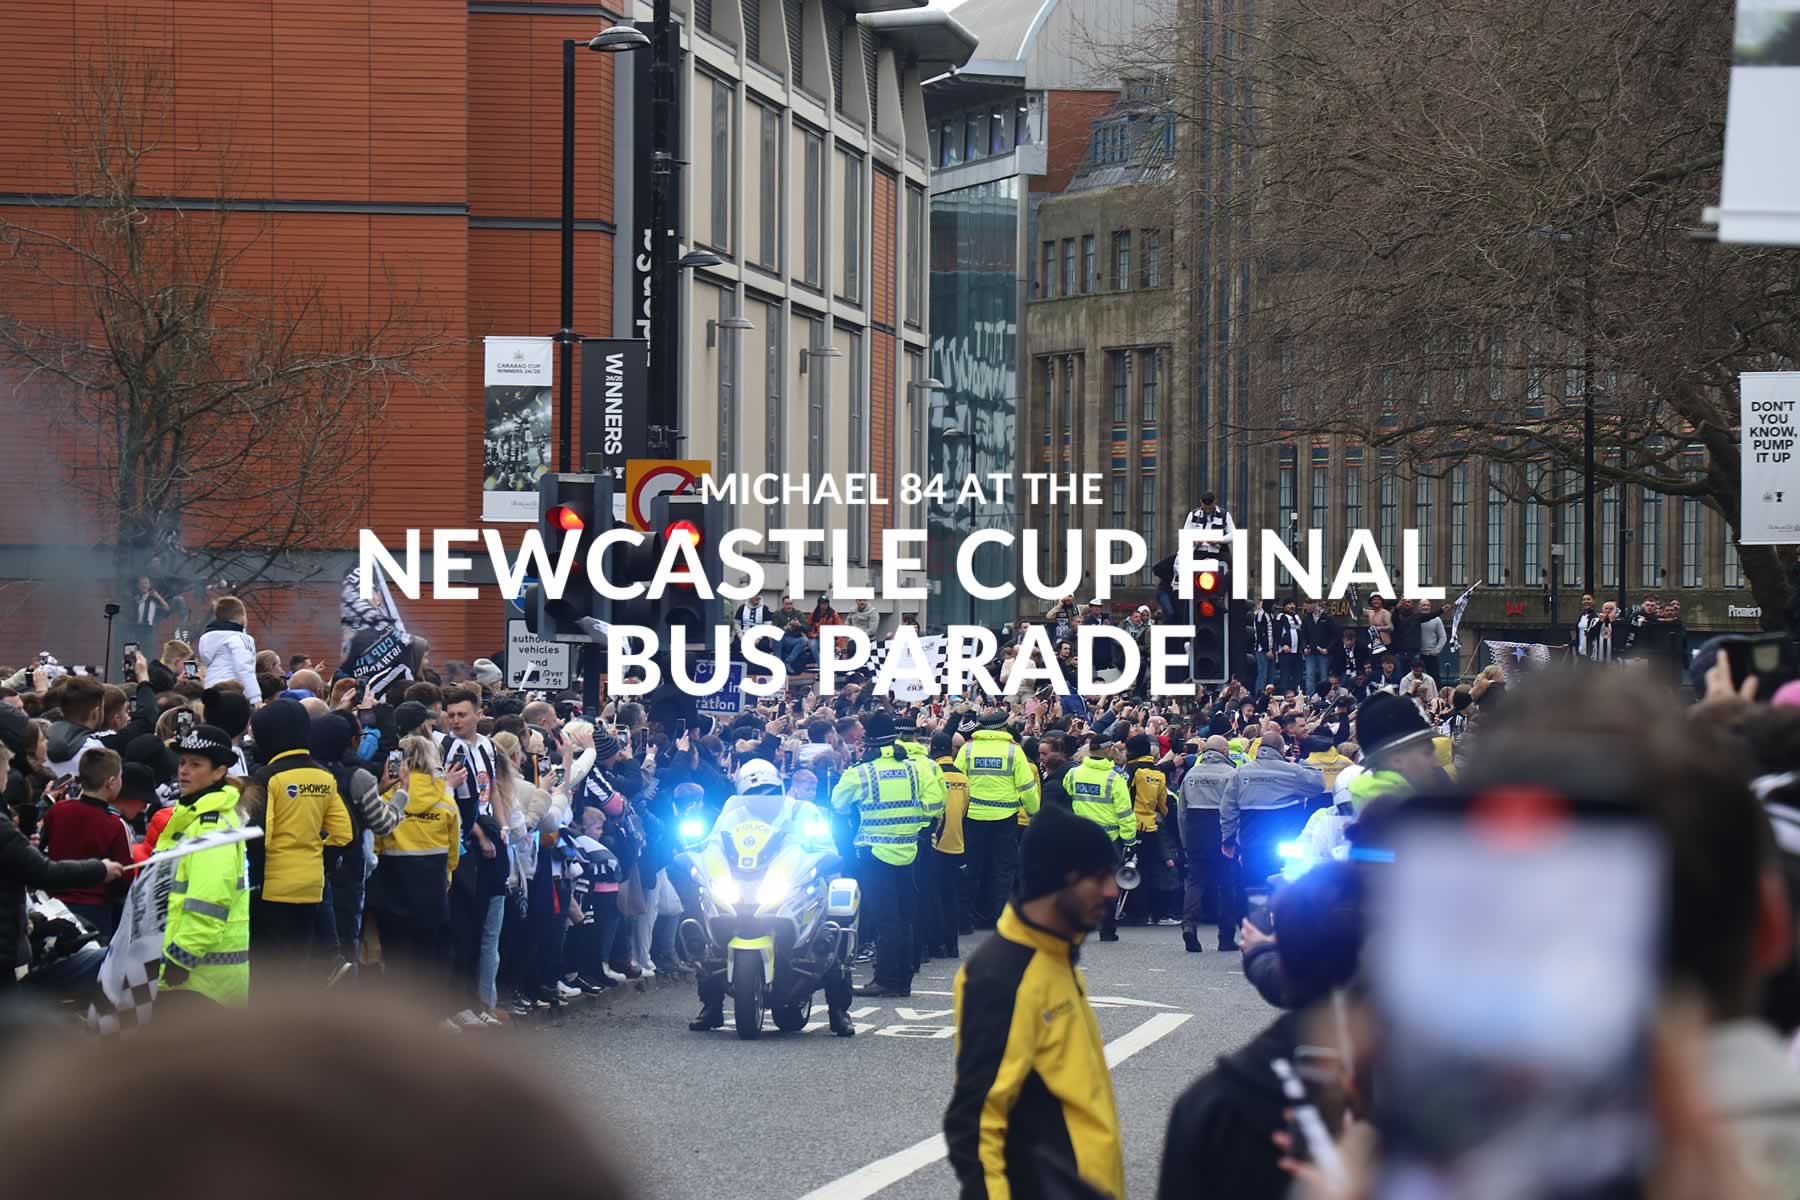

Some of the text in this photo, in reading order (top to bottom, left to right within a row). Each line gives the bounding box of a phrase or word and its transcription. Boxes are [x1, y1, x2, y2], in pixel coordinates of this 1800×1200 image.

[1751, 401, 1796, 411] DON'T
[1758, 414, 1788, 424] YOU
[1750, 426, 1798, 438] KNOW,
[1753, 440, 1794, 450] PUMP
[1756, 452, 1791, 463] IT UP
[519, 645, 559, 654] vehicles
[543, 669, 563, 677] Over
[545, 678, 562, 686] 75t
[975, 758, 1001, 768] POLICE
[880, 769, 906, 779] POLICE
[298, 784, 332, 796] SHOWSEC
[1076, 783, 1100, 794] POLICE
